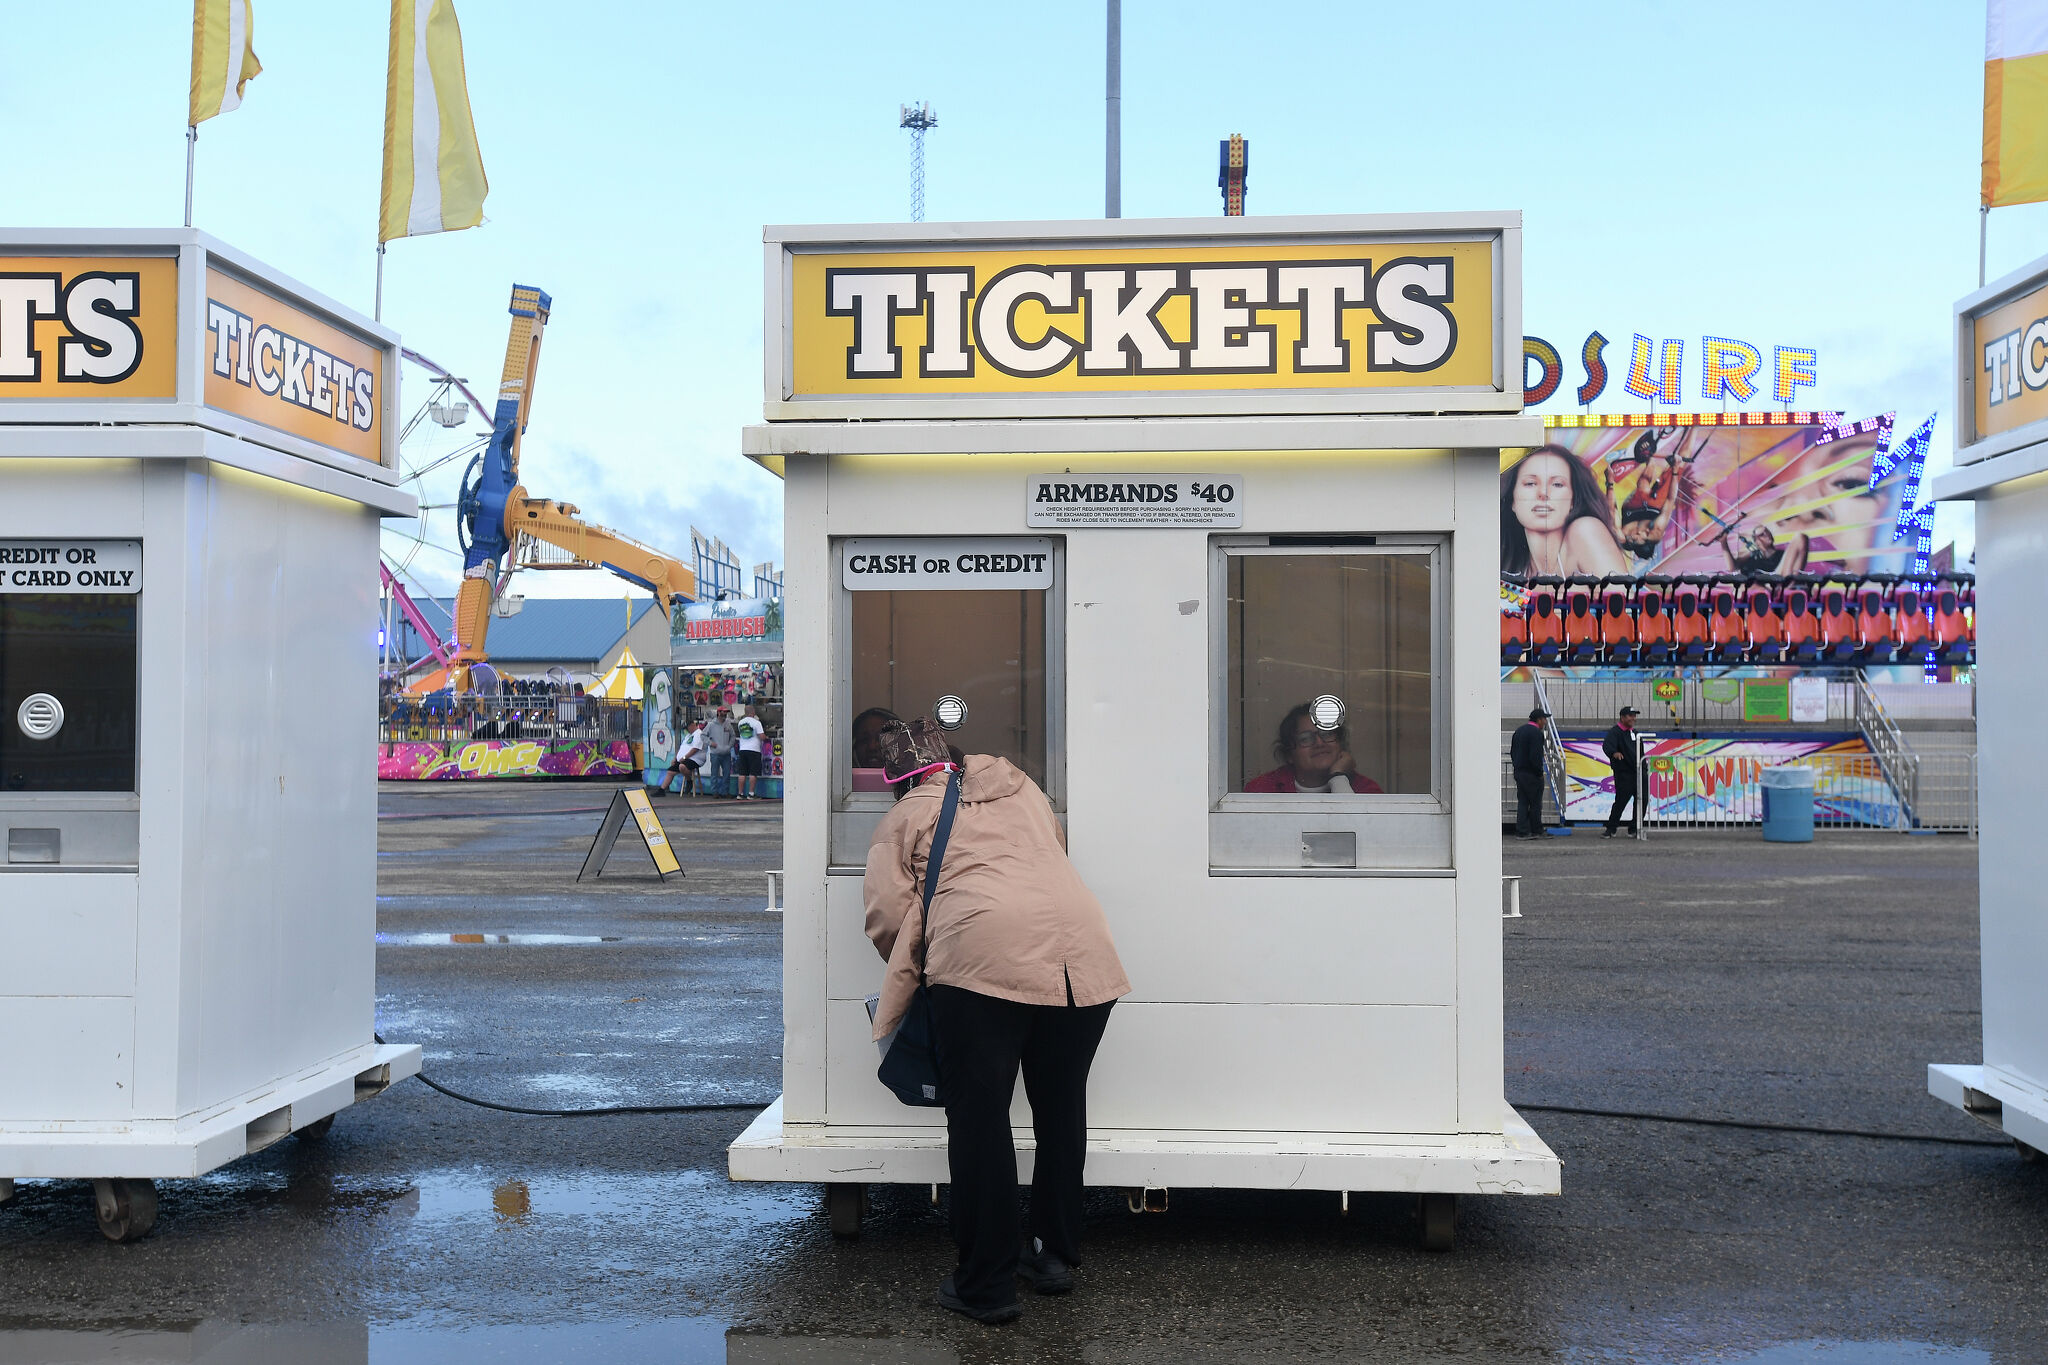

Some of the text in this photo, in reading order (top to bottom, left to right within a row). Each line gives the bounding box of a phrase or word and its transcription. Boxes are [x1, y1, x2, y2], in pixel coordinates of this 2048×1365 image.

[0, 271, 143, 384] TS
[825, 257, 1458, 378] TICKETS
[208, 298, 374, 432] TICKETS
[1984, 316, 2048, 407] TIC
[1036, 482, 1234, 503] ARMBANDS $40
[66, 548, 96, 564] OR
[849, 554, 1046, 574] CASH OR CREDIT
[12, 570, 71, 586] CARD
[77, 570, 134, 586] ONLY
[685, 615, 765, 640] AIRBRUSH
[458, 741, 546, 776] OMG!
